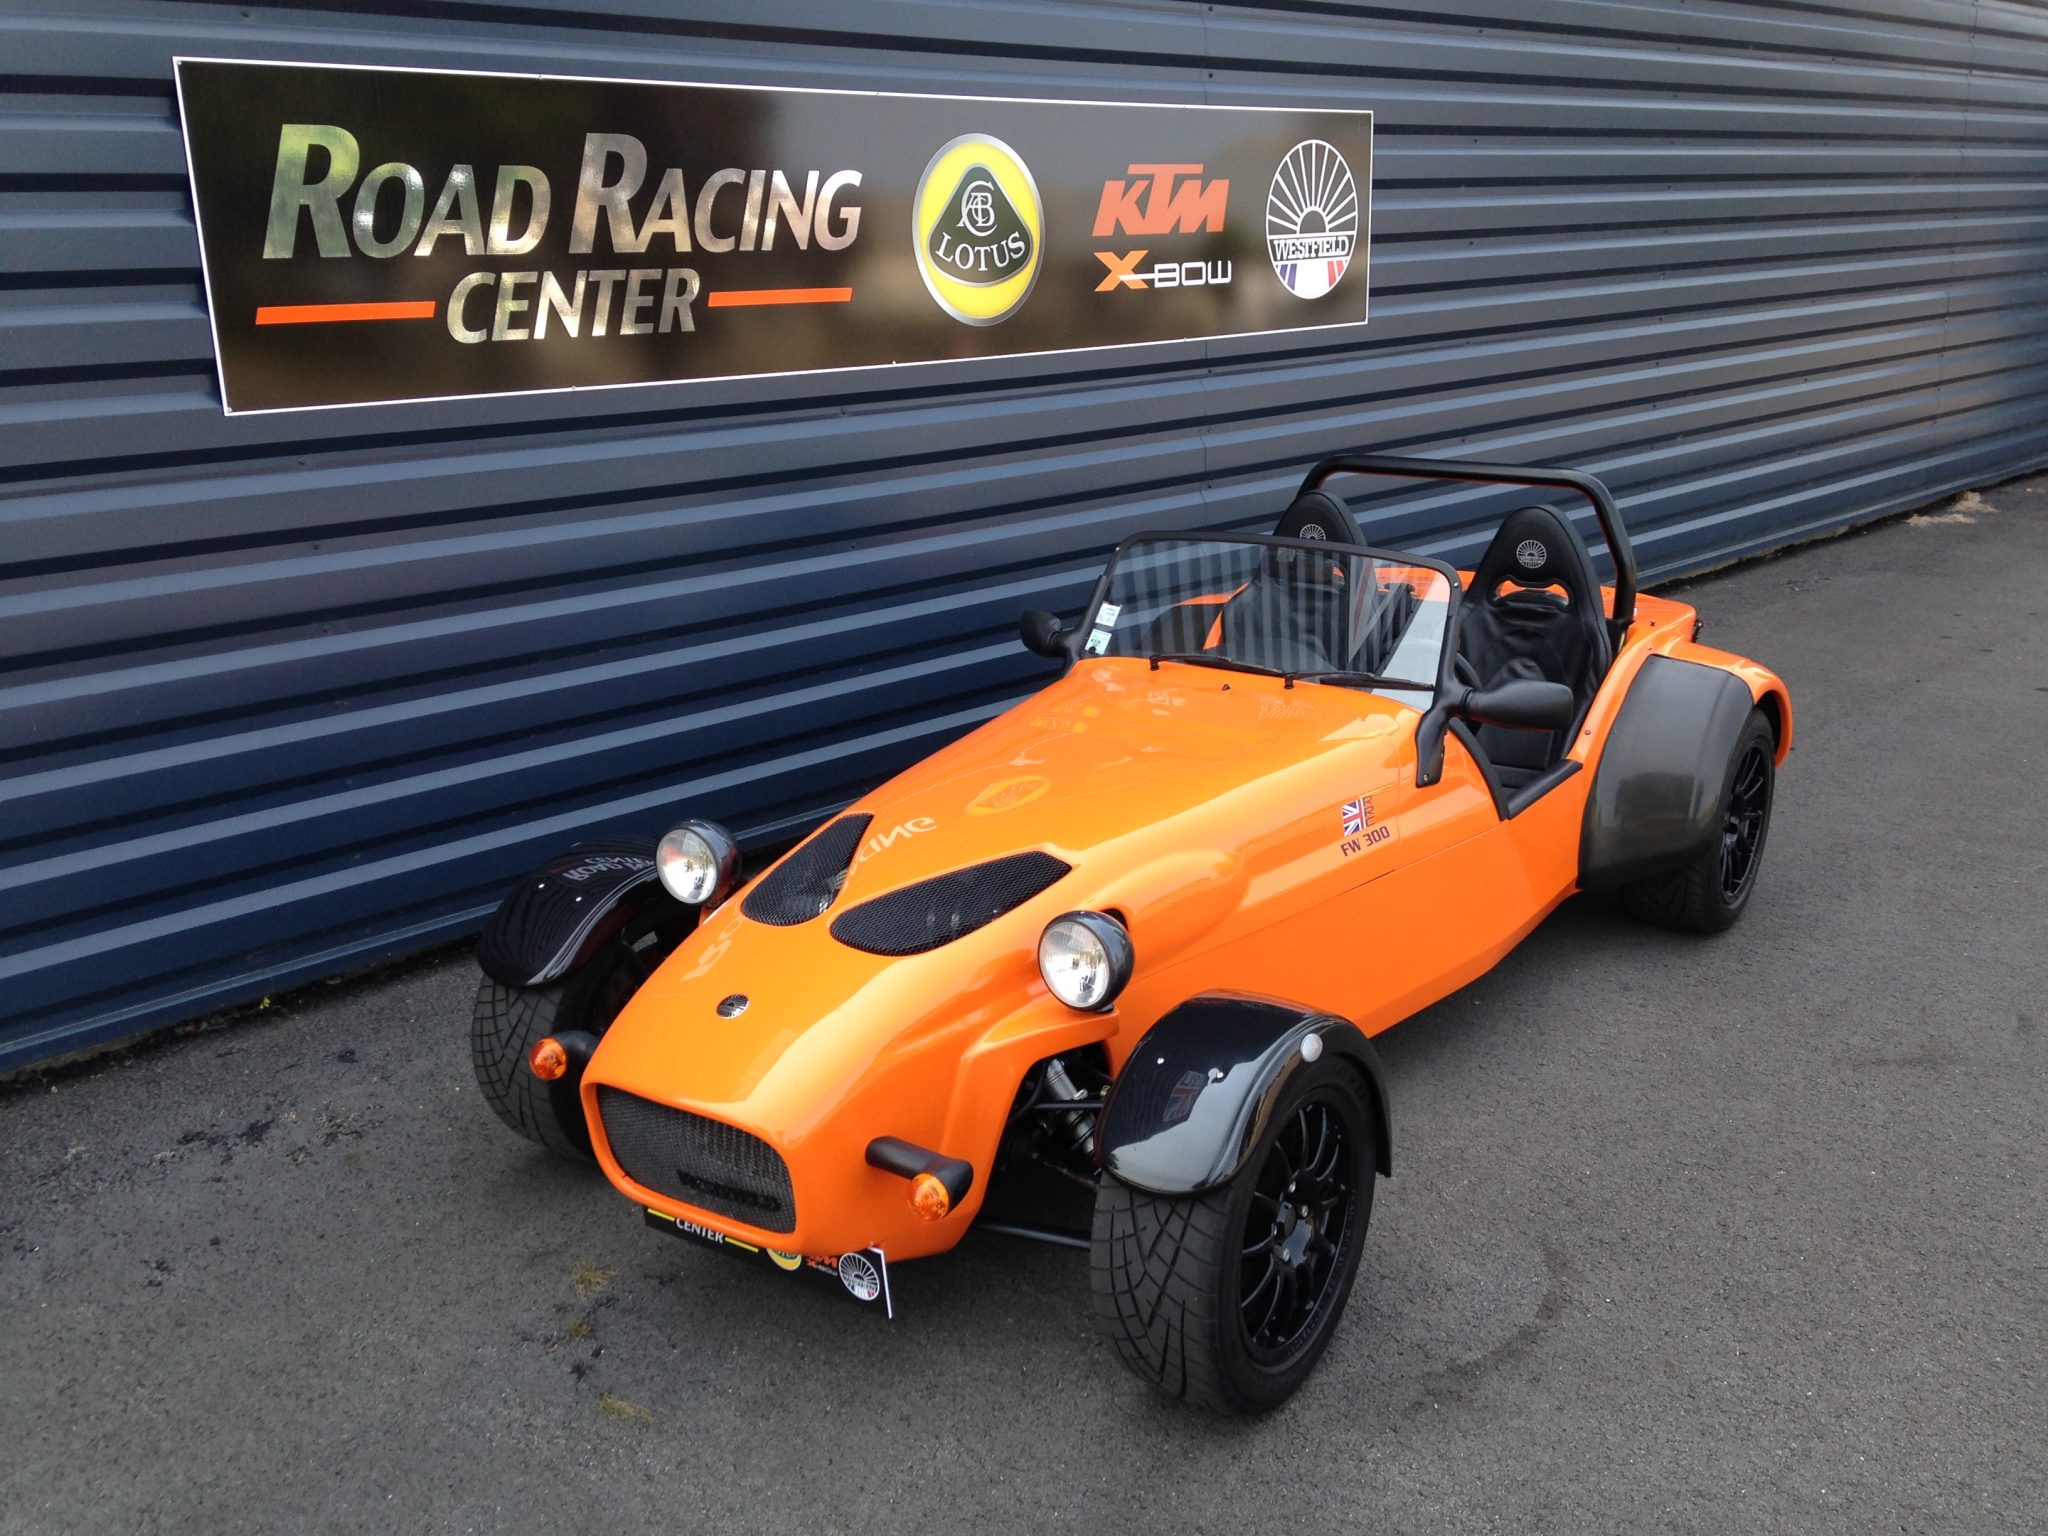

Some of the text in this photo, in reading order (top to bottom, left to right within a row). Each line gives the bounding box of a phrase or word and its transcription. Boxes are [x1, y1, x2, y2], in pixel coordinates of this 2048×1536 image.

[262, 123, 863, 259] ROAD RACING
[1091, 163, 1230, 237] KTM
[935, 231, 1026, 271] LOTUS
[1273, 236, 1350, 260] WESTFIELD
[447, 267, 700, 343] CENTER
[1340, 825, 1390, 856] FW 300
[676, 1218, 723, 1243] CENTER
